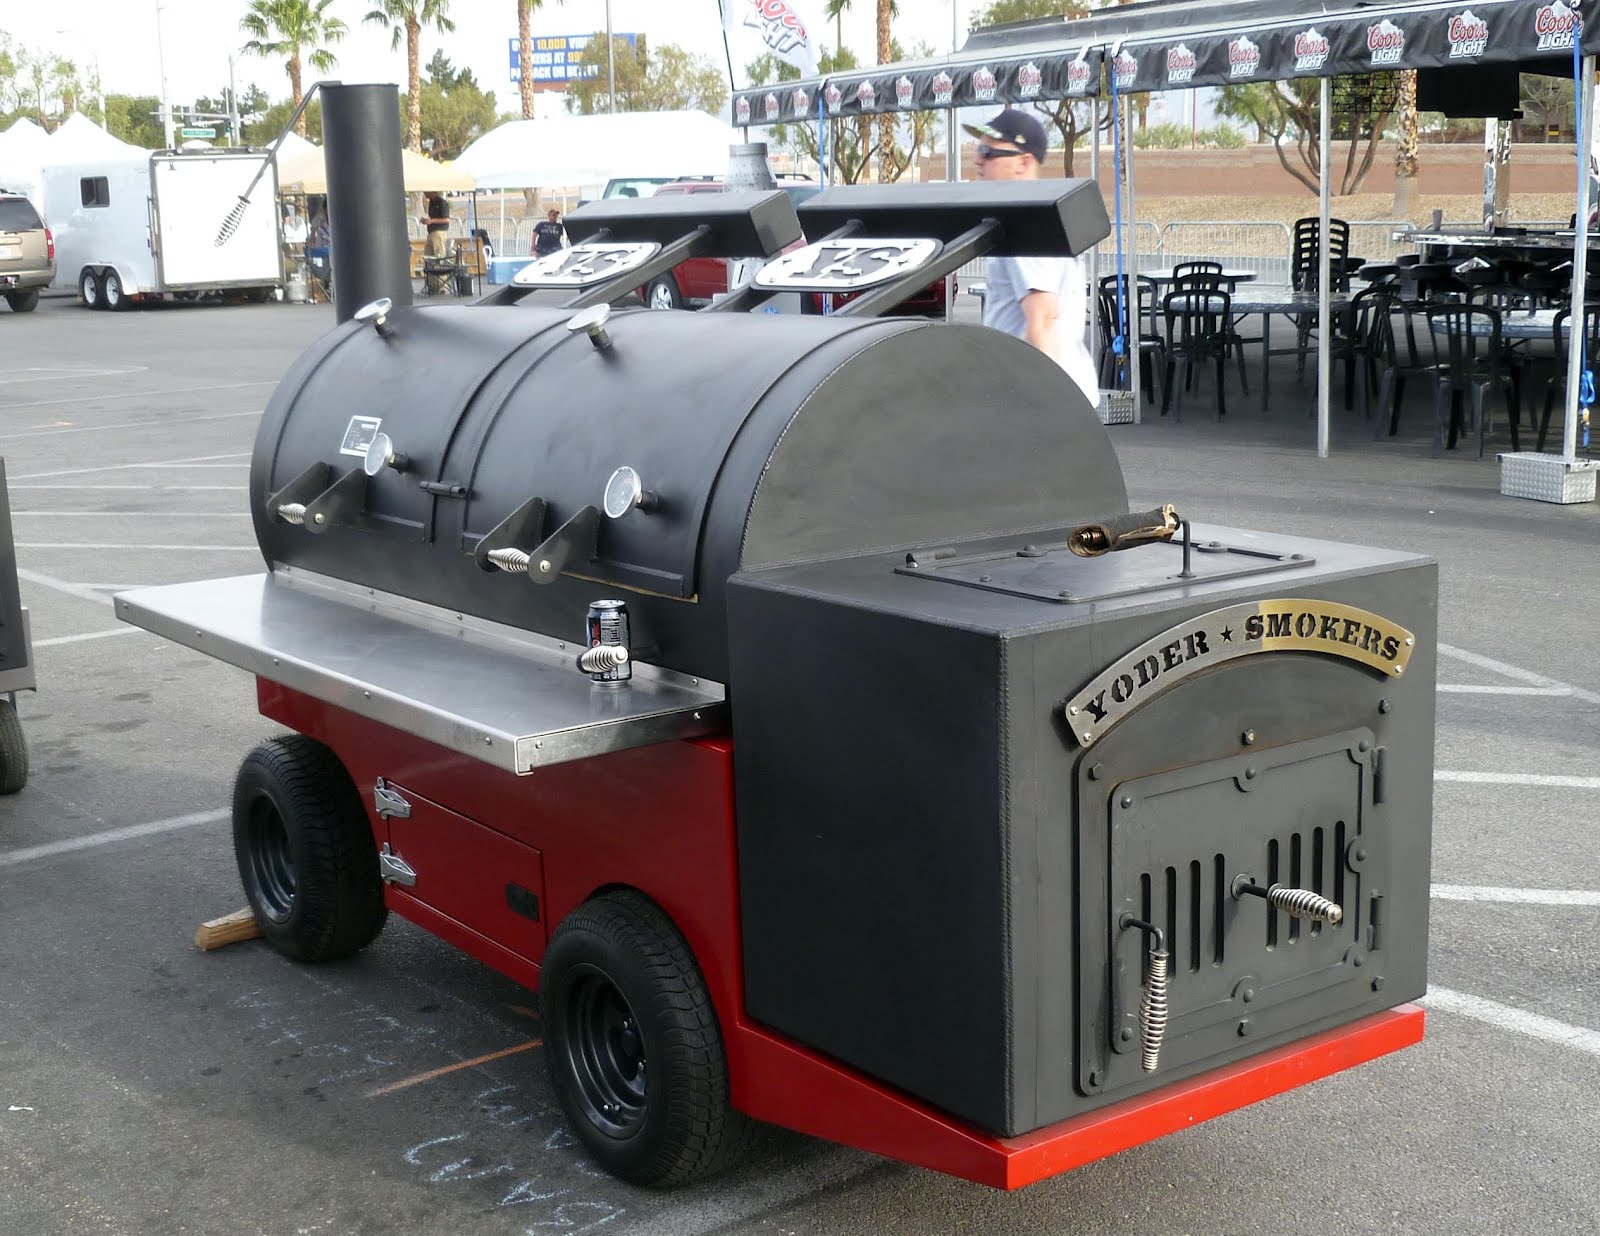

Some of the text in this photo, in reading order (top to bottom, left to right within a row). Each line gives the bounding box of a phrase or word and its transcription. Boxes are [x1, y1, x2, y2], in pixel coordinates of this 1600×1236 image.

[1368, 25, 1405, 49] Coors
[1448, 16, 1488, 41] Coors
[537, 38, 567, 51] 10,000
[1229, 42, 1260, 63] Coors
[1295, 34, 1330, 56] Coors
[1449, 40, 1487, 58] LIGHT
[553, 51, 566, 64] AT
[1167, 49, 1197, 69] Coors
[1295, 55, 1329, 72] LIGHT
[1370, 48, 1403, 65] LIGHT
[1018, 66, 1043, 86] Coors
[1168, 68, 1195, 83] LIGHT
[1230, 61, 1259, 78] LIGHT
[973, 70, 998, 89] Coors
[1081, 612, 1401, 725] YODER SMOKERS
